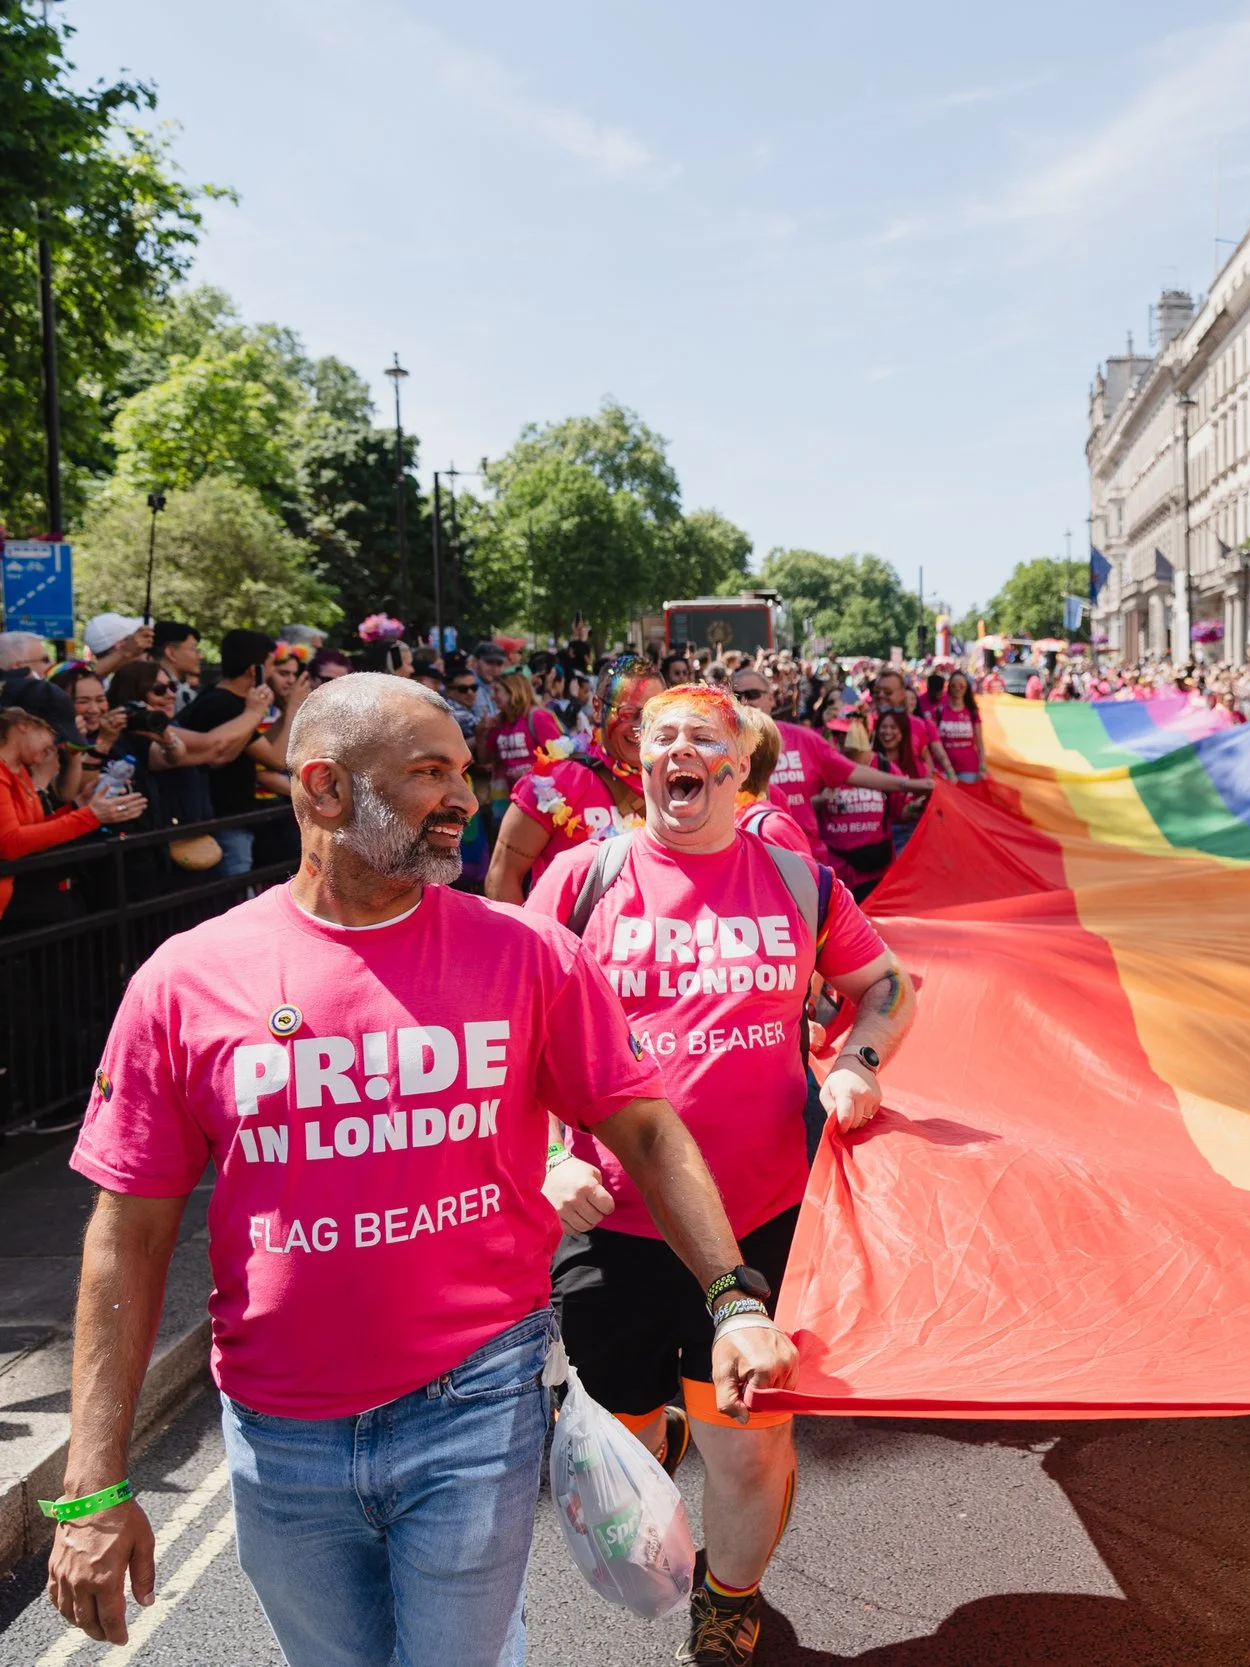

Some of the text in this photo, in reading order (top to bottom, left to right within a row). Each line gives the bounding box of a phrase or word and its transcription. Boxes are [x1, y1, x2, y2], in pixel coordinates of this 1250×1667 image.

[611, 914, 796, 963] PR!DE
[610, 964, 796, 998] IN LONDON
[638, 1021, 785, 1056] AG BEARER
[234, 1020, 511, 1117] PR!DE
[239, 1099, 501, 1164] IN LONDON
[250, 1183, 501, 1254] FLAG BEARER
